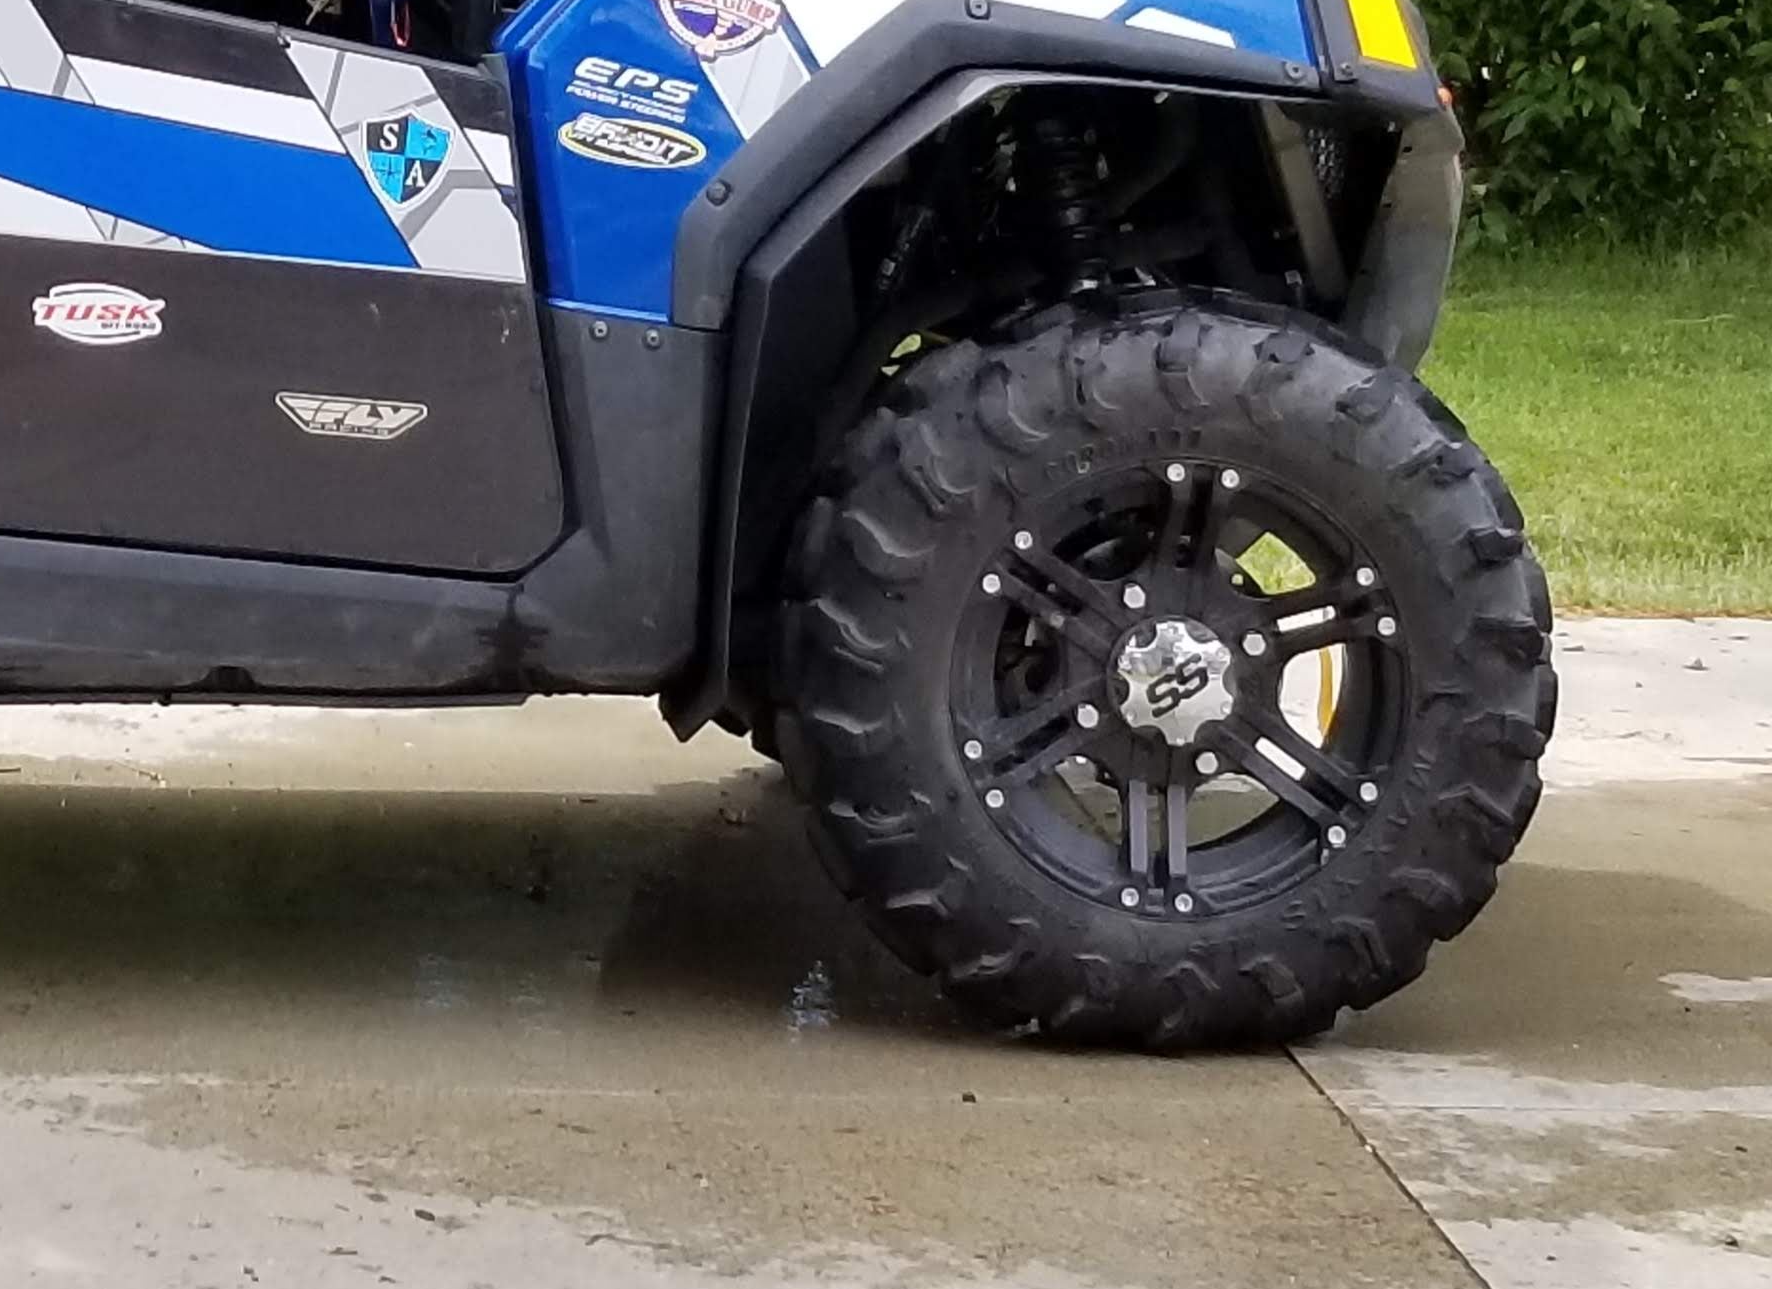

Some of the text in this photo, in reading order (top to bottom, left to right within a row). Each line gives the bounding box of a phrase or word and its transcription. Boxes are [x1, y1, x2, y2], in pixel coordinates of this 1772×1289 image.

[574, 56, 699, 104] EPS
[379, 122, 400, 152] S
[404, 159, 427, 187] A
[39, 303, 159, 321] TUSK
[296, 397, 422, 429] FLY
[1146, 653, 1209, 719] SS
